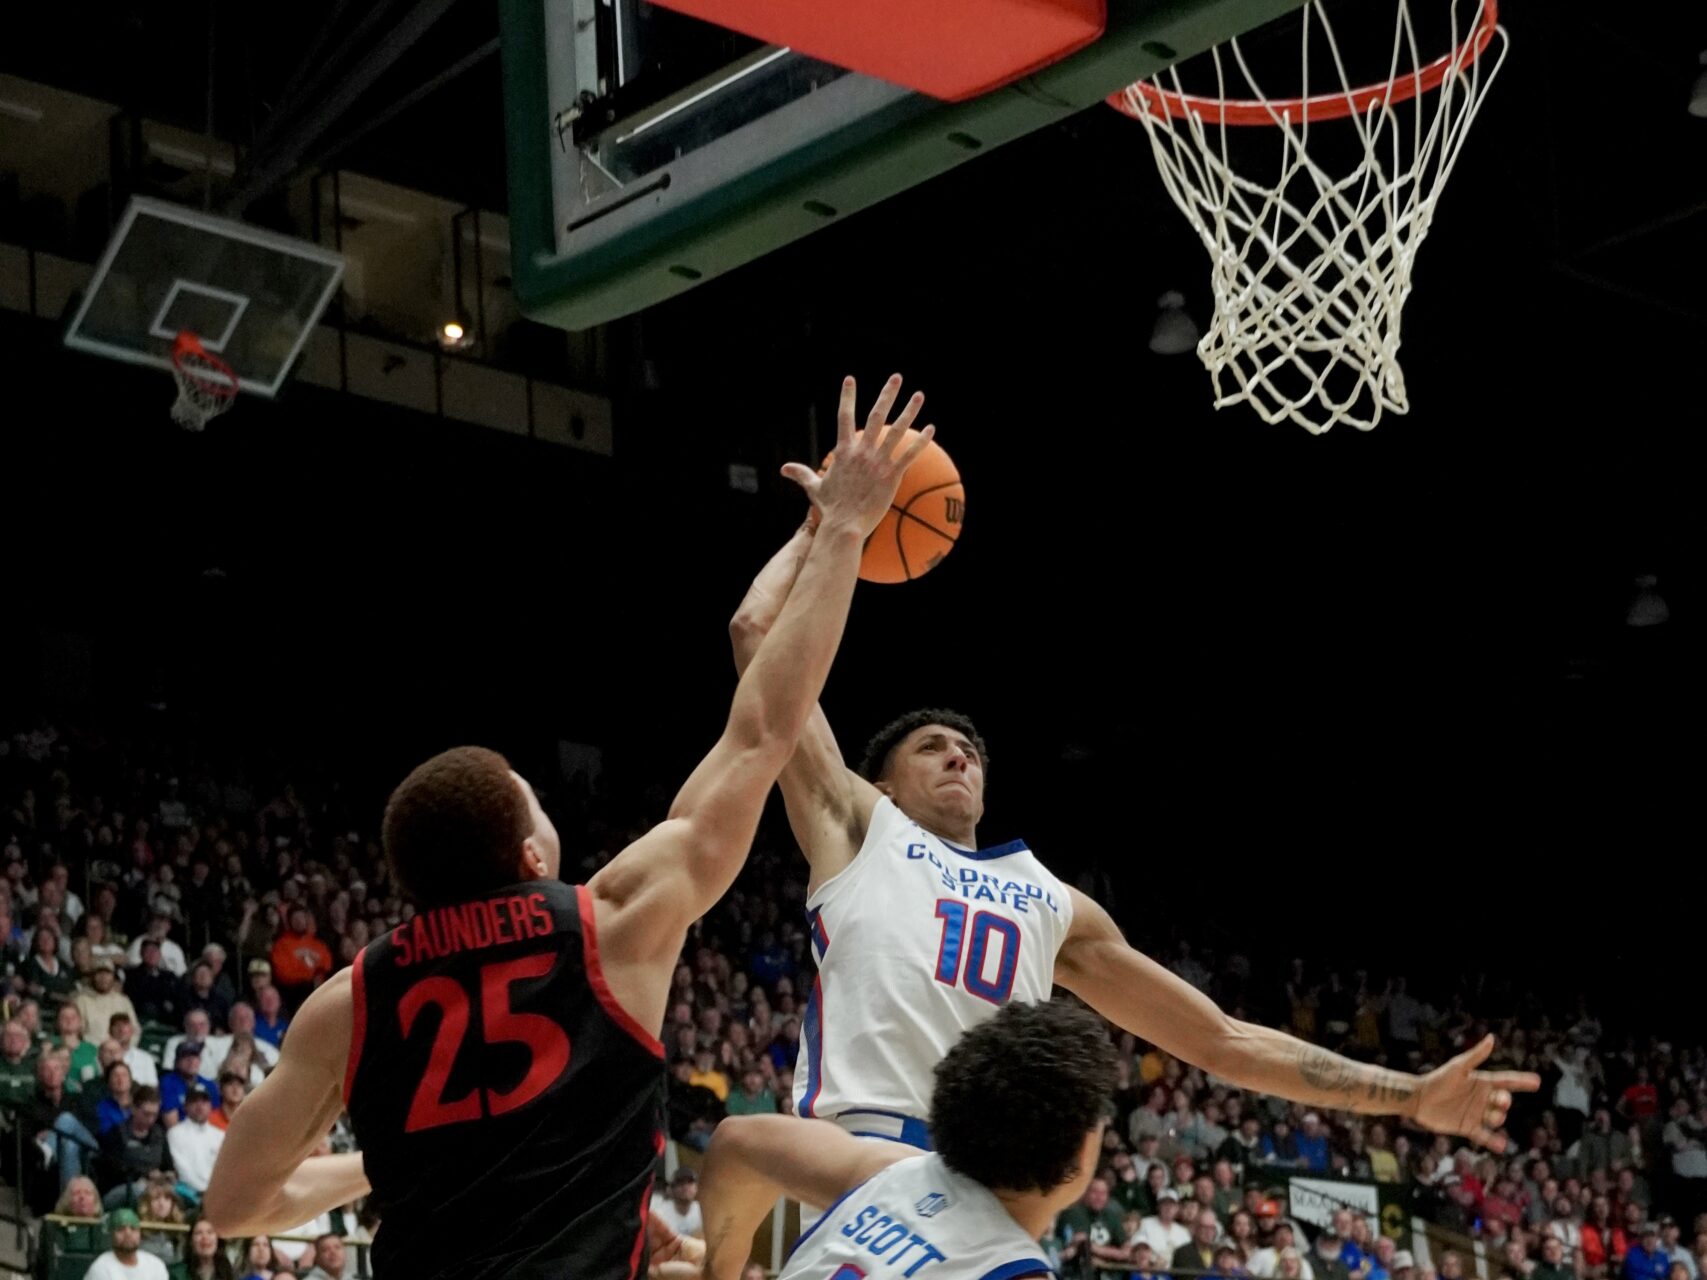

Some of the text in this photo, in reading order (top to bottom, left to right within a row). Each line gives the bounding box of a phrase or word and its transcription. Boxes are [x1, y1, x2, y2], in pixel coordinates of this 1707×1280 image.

[391, 892, 555, 968] SAUNDERS
[934, 898, 1022, 1007] 10
[397, 951, 571, 1134] 25
[840, 1205, 948, 1280] SCOTT
